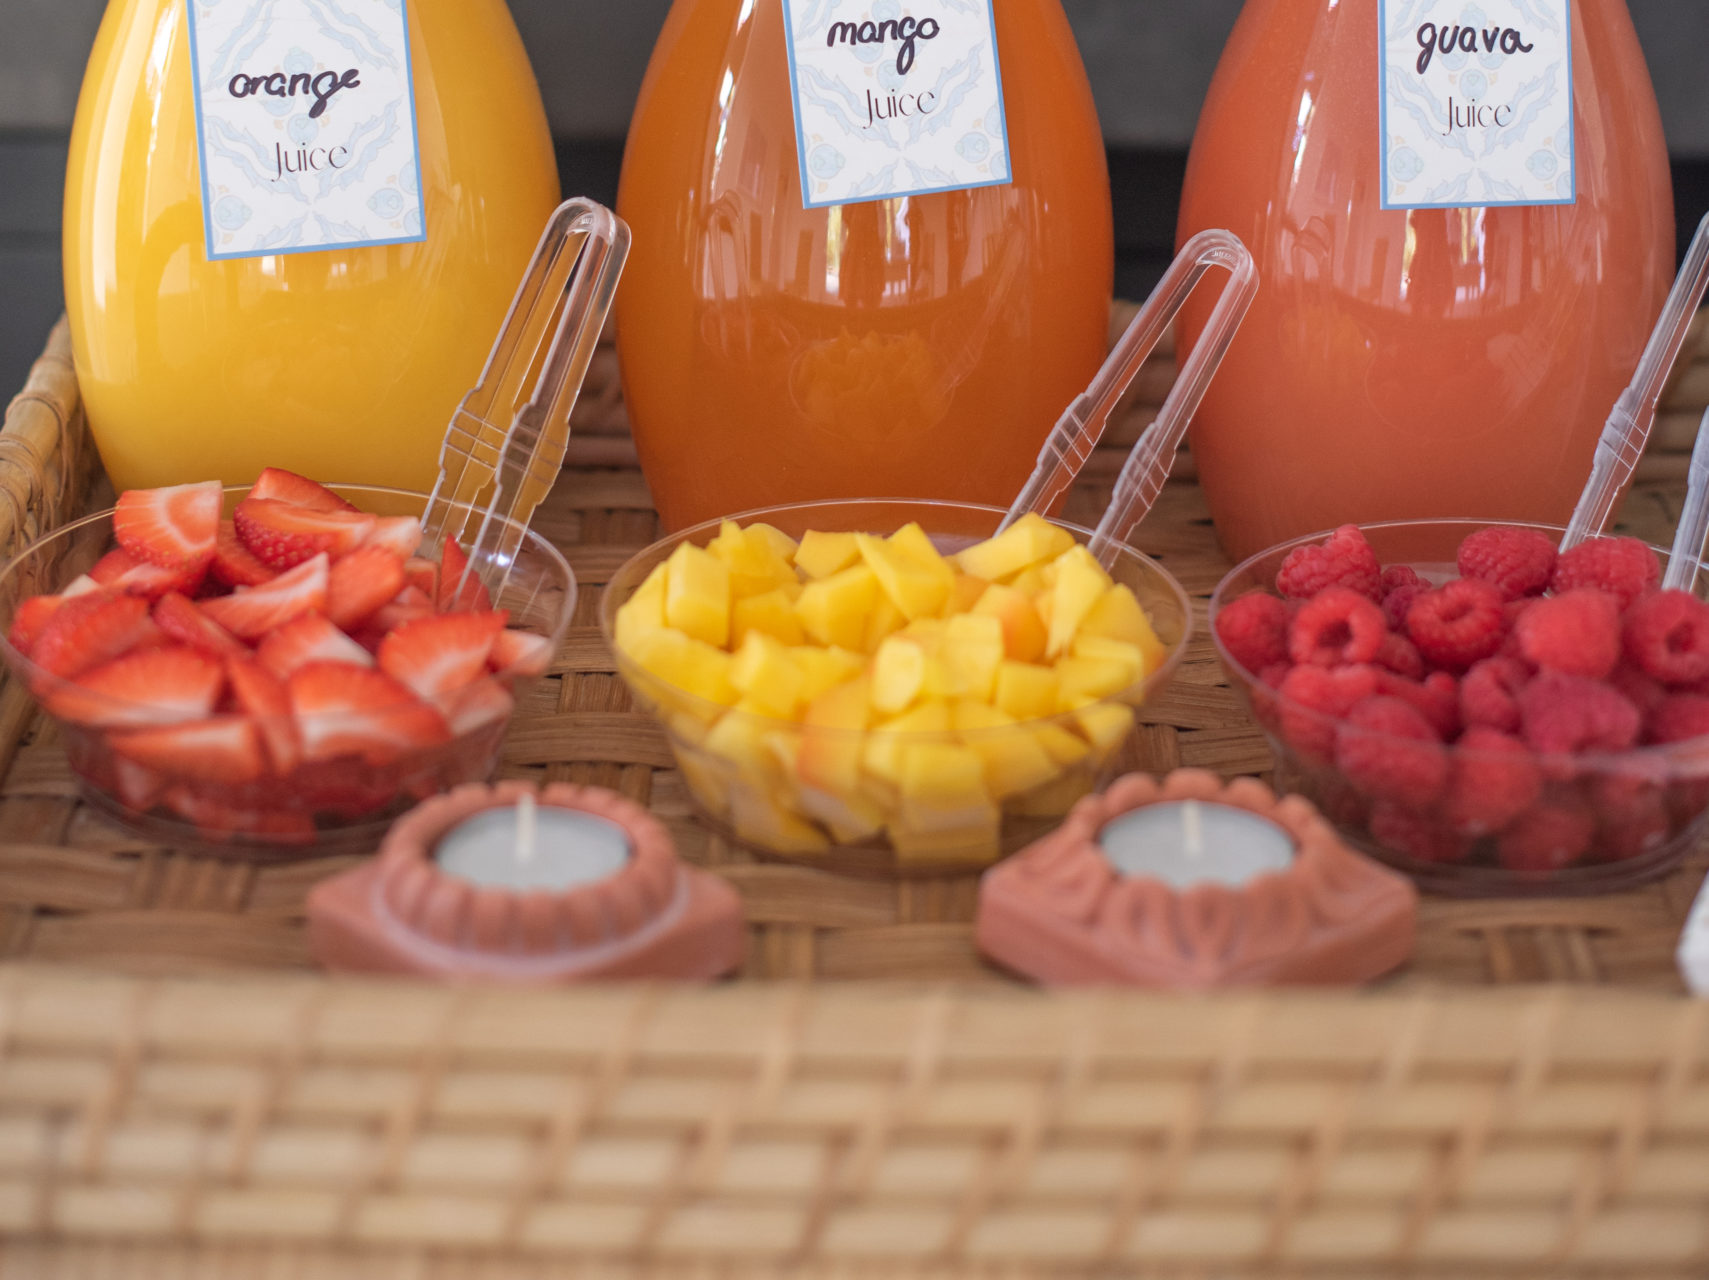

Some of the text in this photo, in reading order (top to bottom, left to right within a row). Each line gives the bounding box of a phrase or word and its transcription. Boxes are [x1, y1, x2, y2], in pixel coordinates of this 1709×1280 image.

[826, 15, 940, 75] mango
[1416, 22, 1533, 74] guava
[228, 68, 360, 118] orange
[862, 88, 935, 129] Juice
[1442, 96, 1511, 136] Juice
[271, 142, 347, 181] Juice
